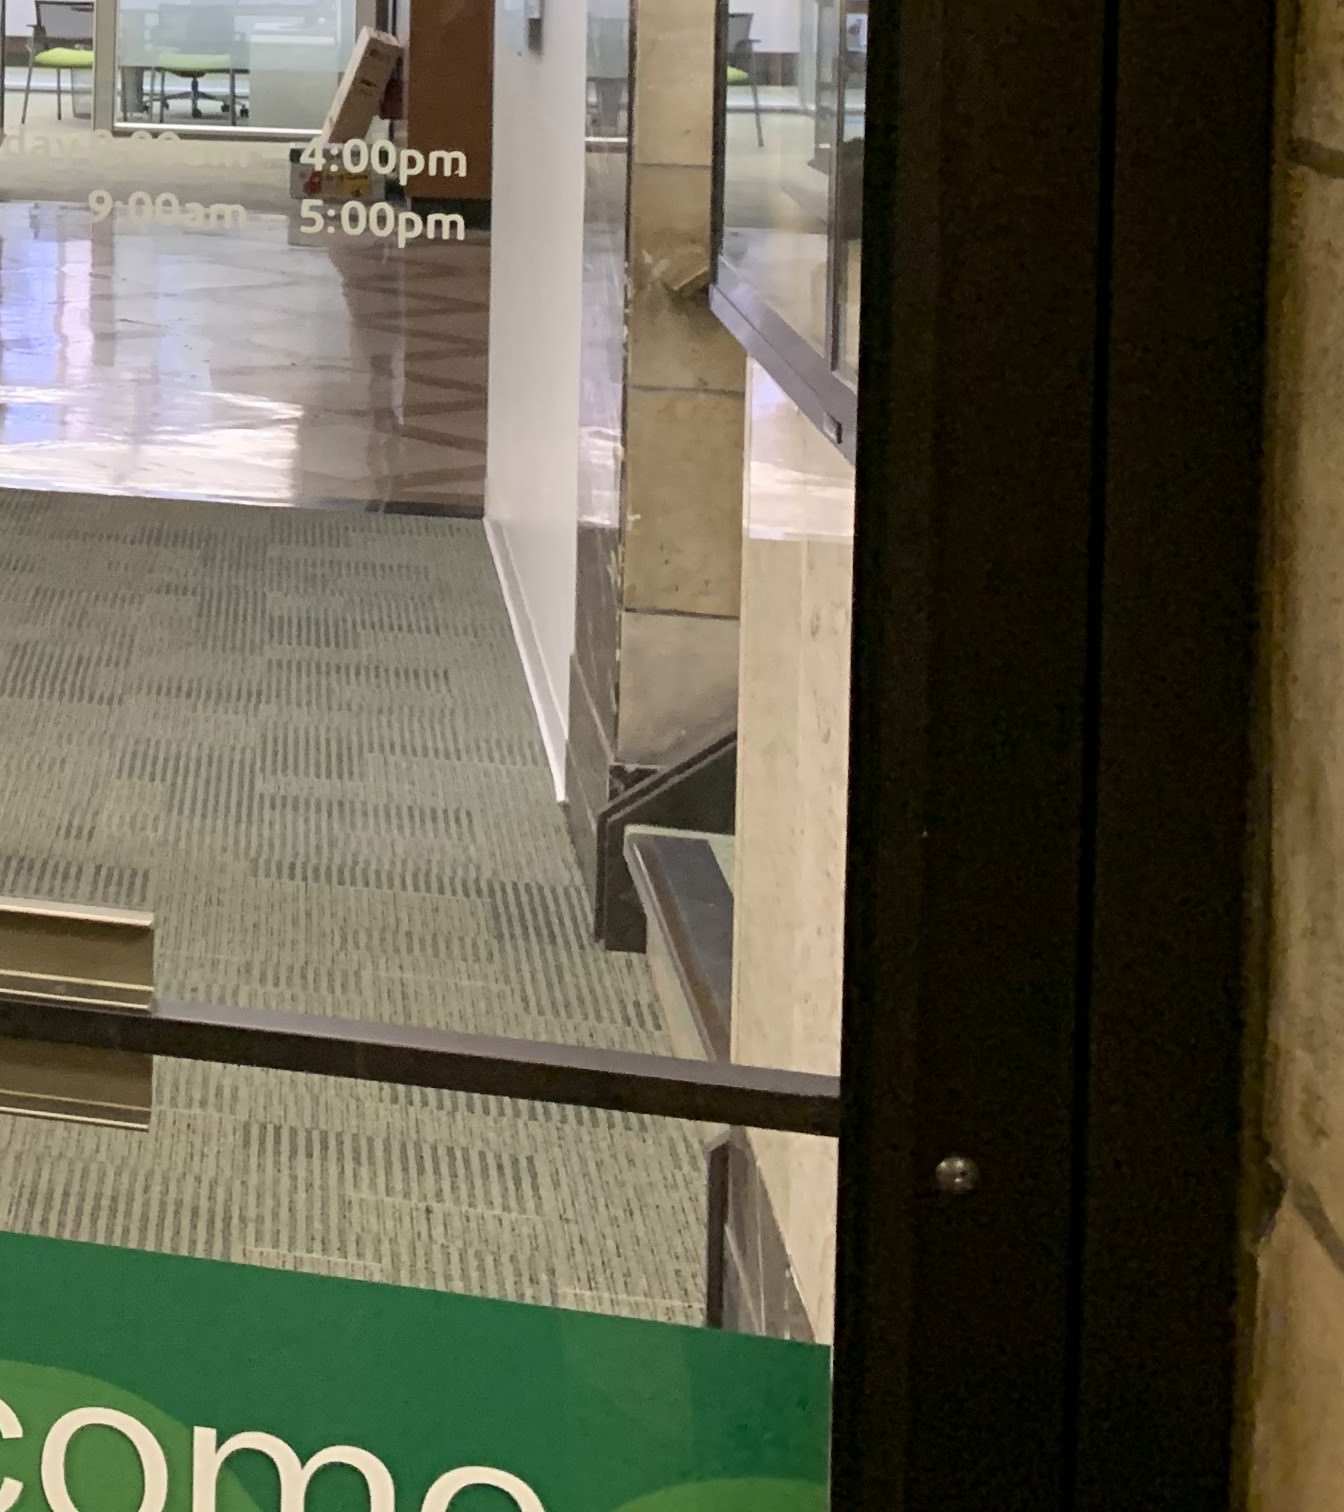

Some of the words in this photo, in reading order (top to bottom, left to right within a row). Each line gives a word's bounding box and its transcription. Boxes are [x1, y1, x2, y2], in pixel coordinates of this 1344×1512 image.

[299, 138, 467, 185] 4:00pm
[88, 189, 247, 229] 9:00am
[299, 198, 466, 247] 5:00pm
